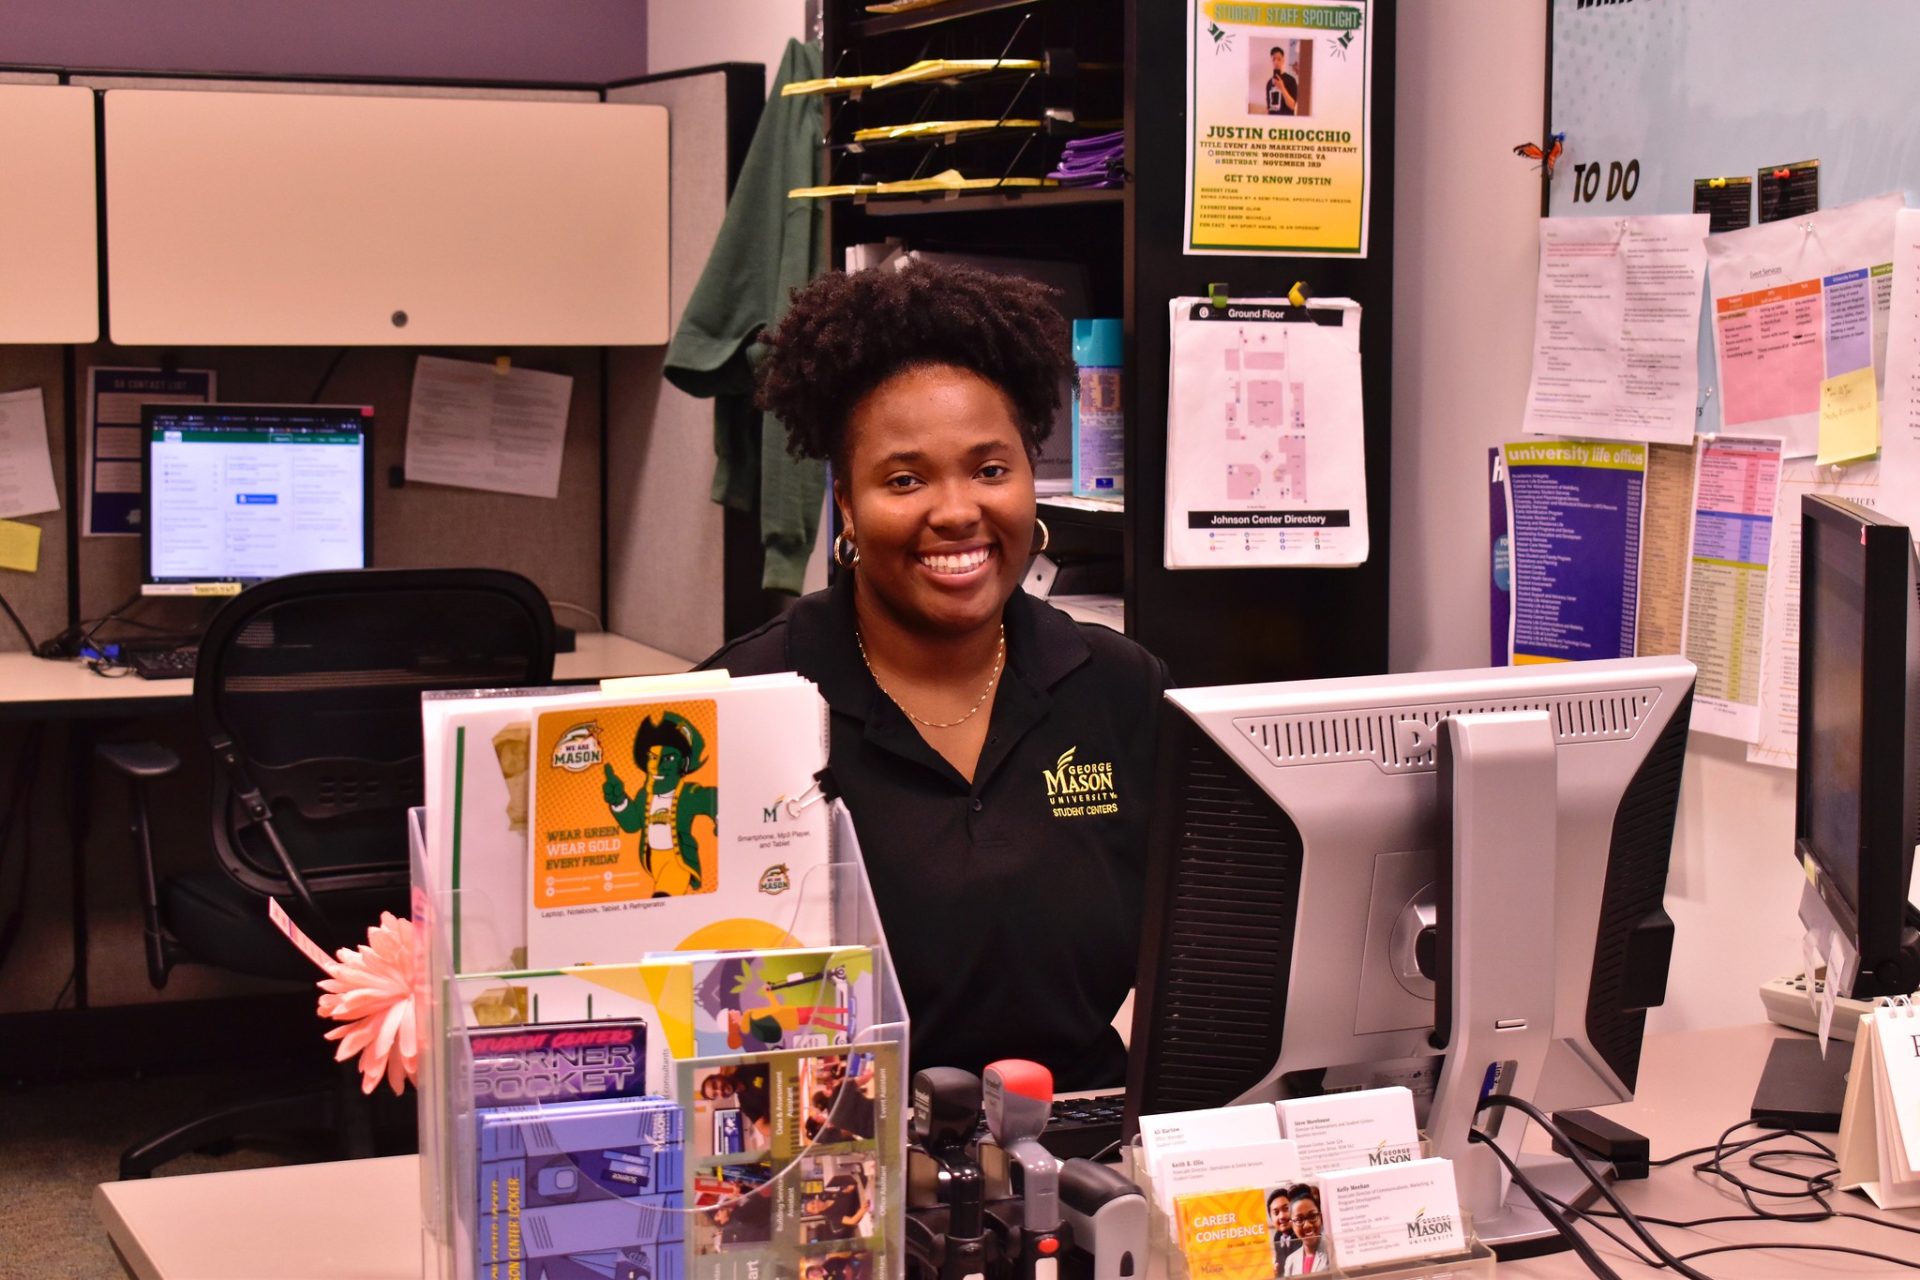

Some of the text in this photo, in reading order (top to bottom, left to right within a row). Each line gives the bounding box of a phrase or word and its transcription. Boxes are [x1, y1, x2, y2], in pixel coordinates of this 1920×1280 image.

[1215, 4, 1359, 28] STUDENT STAFF SPOTLIGHT
[1207, 125, 1351, 143] JUSTIN CHIOCCHIO
[1269, 144, 1315, 152] MARKETING
[1317, 145, 1358, 154] ASSISTANT
[1262, 159, 1305, 167] NOVEMBER
[1224, 174, 1332, 186] GET TO KNOW JUSTIN
[1573, 158, 1640, 203] TO DO
[1228, 308, 1285, 319] Ground Floor
[1508, 446, 1589, 465] university
[1592, 447, 1611, 463] life
[1211, 514, 1326, 525] Johnson Center Directory
[554, 750, 600, 765] MASON
[1068, 762, 1112, 775] GEORGE
[1042, 767, 1114, 796] MASON
[1049, 792, 1115, 805] UNIVERSITY
[1052, 803, 1118, 817] STUDENT CENTERS
[547, 825, 620, 842] WEAR GREEN
[546, 838, 622, 857] WEAR GOLD
[545, 853, 620, 871] EVERY FRIDAY
[471, 1029, 634, 1053] STUDENT CENTERS
[471, 1067, 635, 1100] POCKET
[652, 1111, 666, 1153] MASON
[1383, 1147, 1411, 1156] GEORGE
[507, 1178, 521, 1261] CENTER LOCKER
[1193, 1213, 1237, 1228] CAREER
[1195, 1224, 1266, 1243] CONFIDENCE
[1407, 1220, 1453, 1239] MASON
